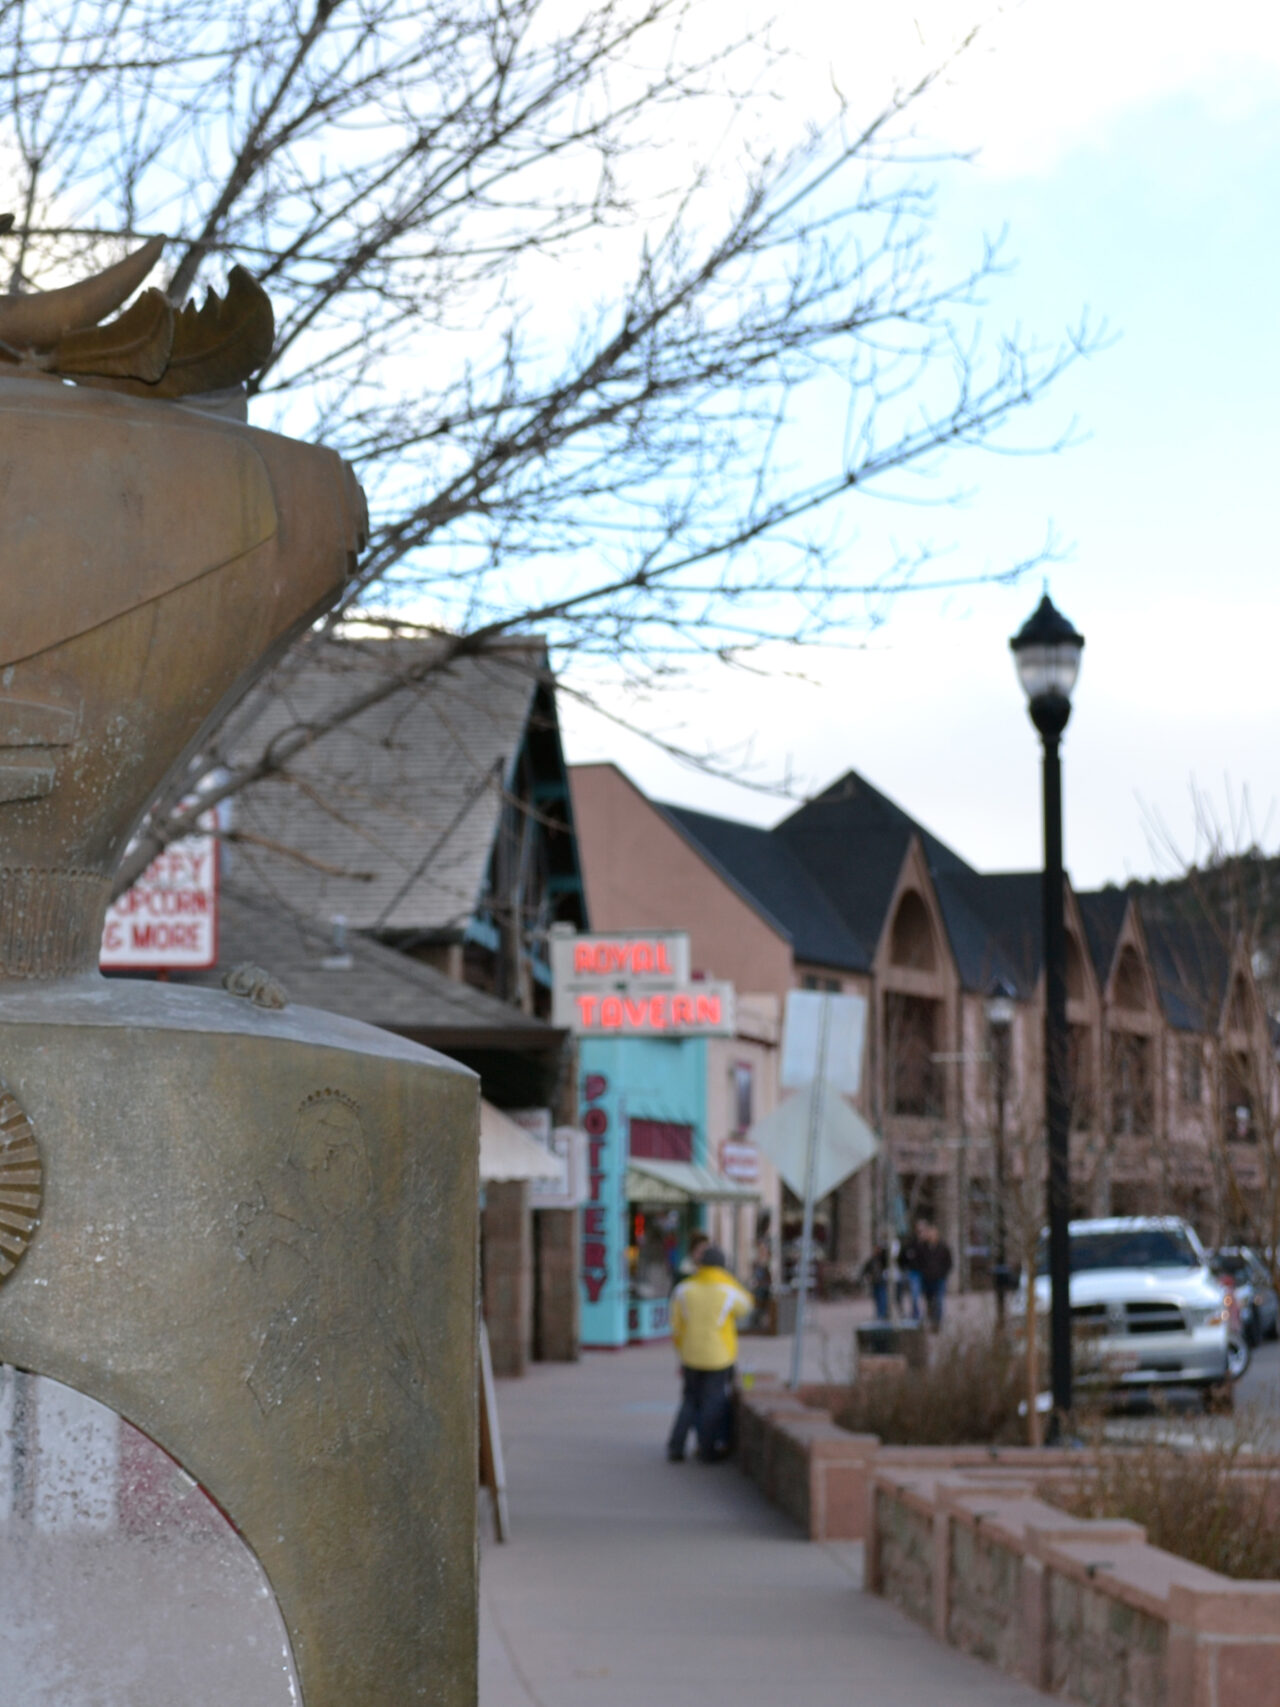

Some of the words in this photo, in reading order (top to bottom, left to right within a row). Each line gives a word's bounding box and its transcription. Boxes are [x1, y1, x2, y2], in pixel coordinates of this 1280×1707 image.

[115, 888, 208, 915] OPCORN
[132, 922, 201, 951] MORE
[574, 942, 674, 975] ROYAL
[576, 995, 722, 1029] TAVERN
[584, 1074, 608, 1304] POTTERY
